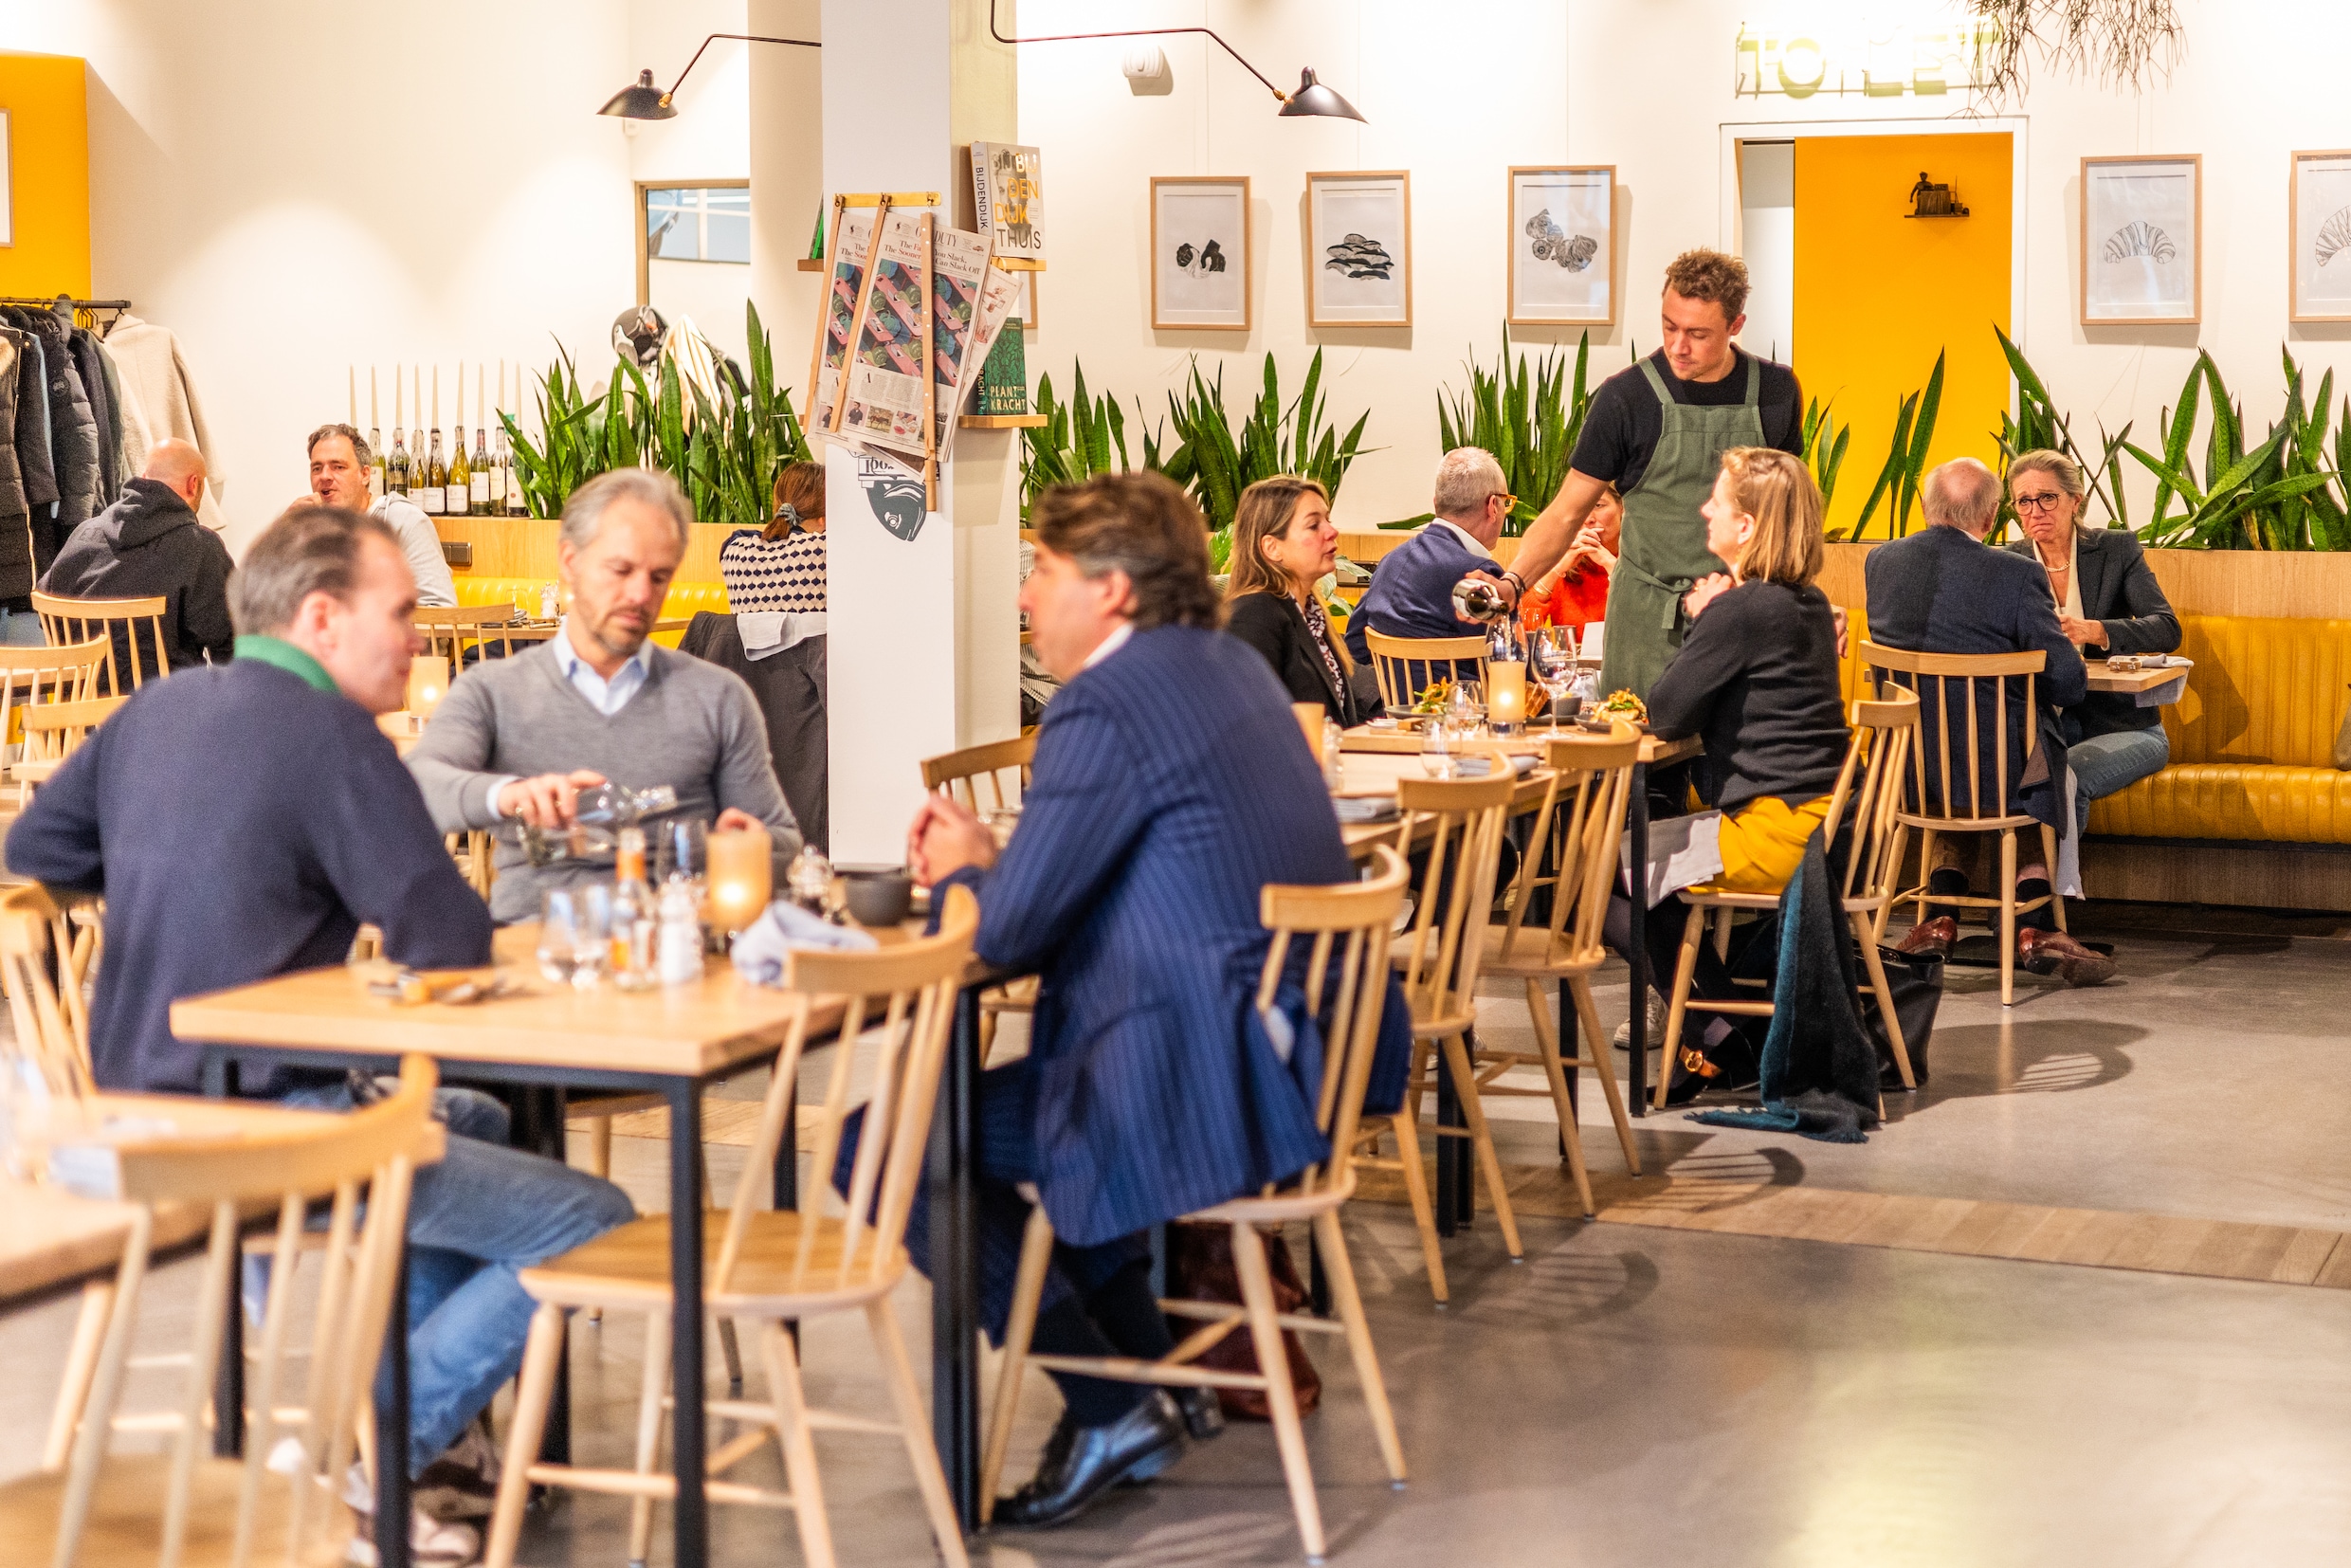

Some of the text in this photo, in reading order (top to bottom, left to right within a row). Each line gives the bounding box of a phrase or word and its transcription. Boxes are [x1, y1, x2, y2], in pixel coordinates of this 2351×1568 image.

[1739, 16, 1998, 97] TOILET
[1015, 153, 1038, 173] BIJ
[1007, 177, 1039, 199] DEN
[975, 167, 989, 229] BIJDENDIJK
[994, 202, 1030, 225] DIJK
[900, 239, 913, 249] The
[934, 230, 958, 246] DUTY
[996, 228, 1042, 249] THUIS
[841, 247, 867, 260] The Soo
[854, 242, 866, 251] The
[884, 244, 897, 253] The
[899, 248, 921, 260] Sooner
[935, 258, 949, 266] Can
[949, 261, 968, 271] Slack
[990, 386, 1017, 397] PLANT
[991, 398, 1026, 410] KRACHT
